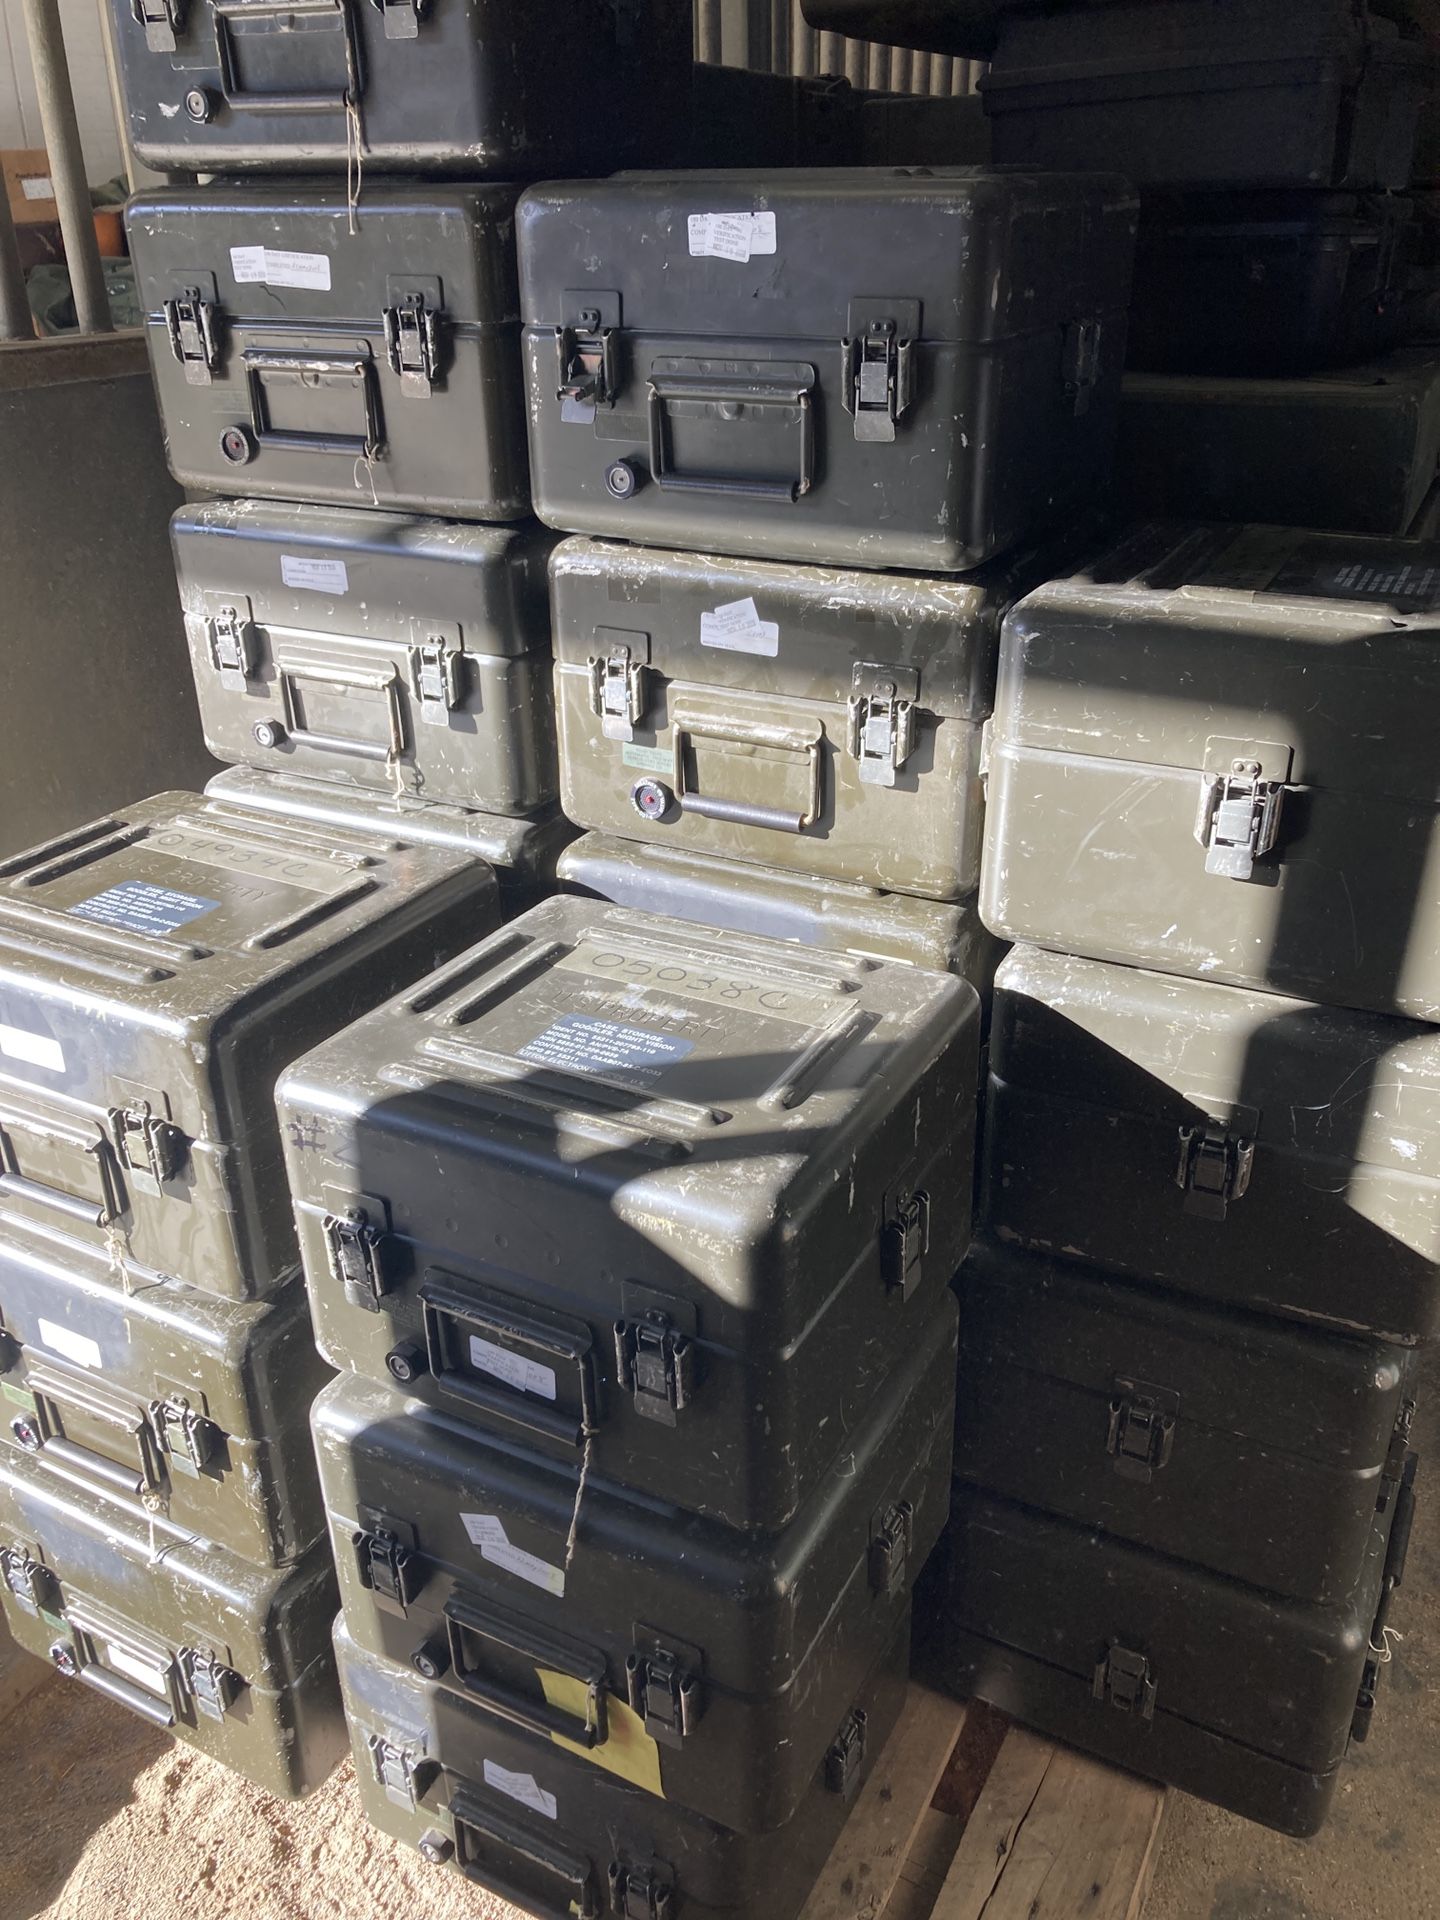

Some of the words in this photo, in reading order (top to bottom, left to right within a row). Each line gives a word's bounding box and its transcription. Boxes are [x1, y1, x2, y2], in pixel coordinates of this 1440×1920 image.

[158, 833, 308, 878] 04934C
[592, 952, 789, 1010] 05038C
[552, 1024, 576, 1034] IDENT
[594, 1000, 737, 1042] PROPERTY
[546, 1030, 571, 1040] MODEL
[616, 1033, 644, 1043] NIGHT
[645, 1040, 675, 1051] VISION
[533, 1040, 575, 1053] CONTRACT
